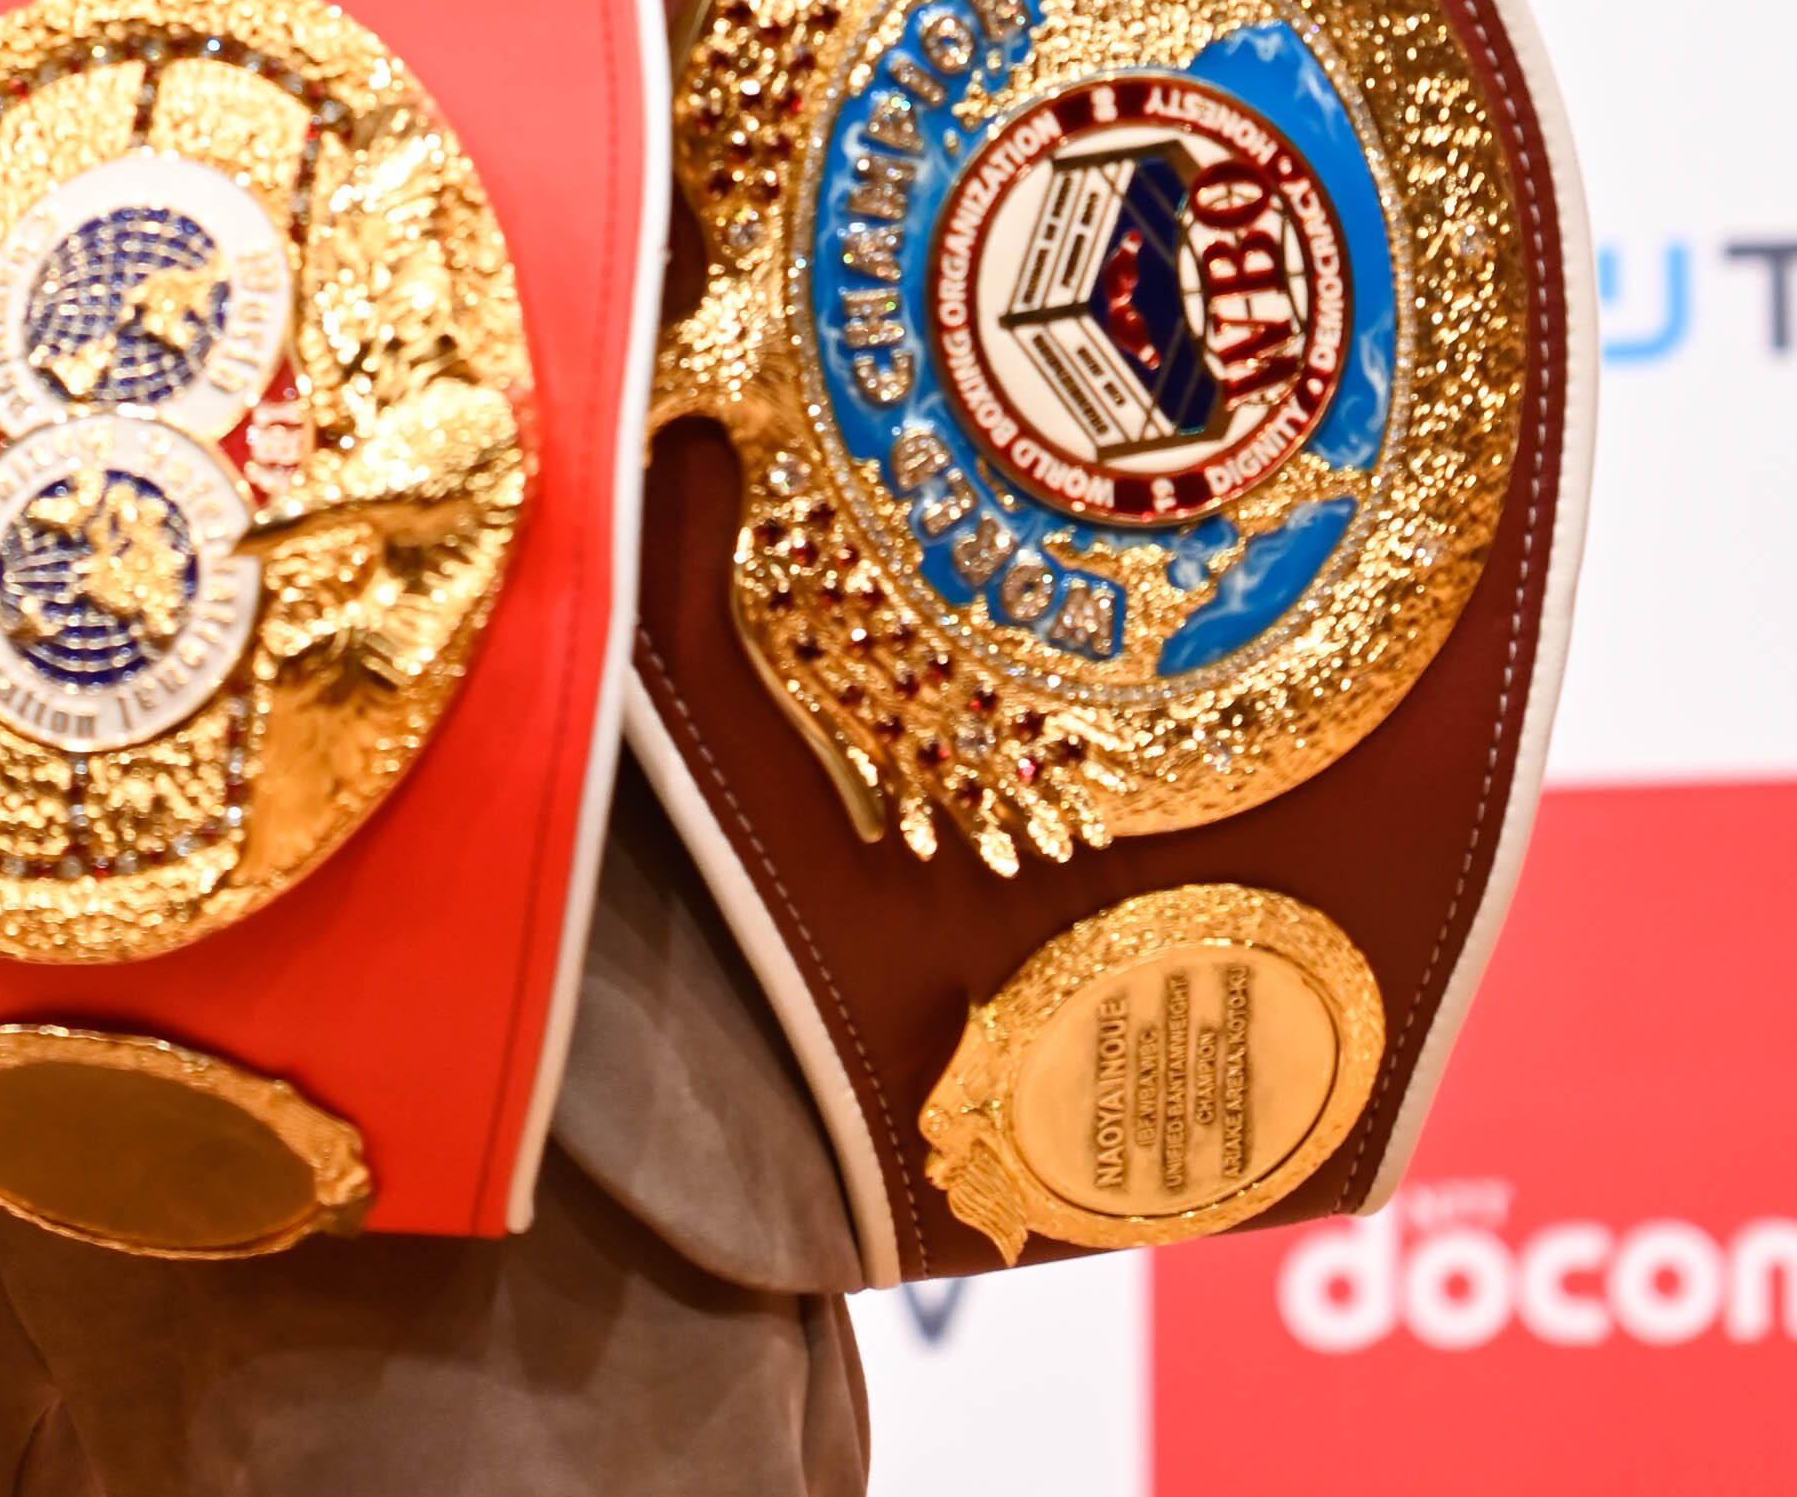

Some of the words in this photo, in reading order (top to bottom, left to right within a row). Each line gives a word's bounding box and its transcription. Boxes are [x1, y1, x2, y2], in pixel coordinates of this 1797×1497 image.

[1143, 86, 1279, 166] HONESTY
[936, 111, 1064, 324] ORGANIZATION
[1190, 158, 1308, 410] WBO
[1278, 178, 1344, 372] DEMOCRACY
[941, 326, 1017, 448] BOXING
[1011, 438, 1116, 509] WORLD
[1205, 394, 1308, 496] DIGNITY
[892, 424, 1125, 660] WORLD
[1097, 999, 1127, 1084] INOUE
[1195, 1030, 1217, 1125] CHAMPION
[1096, 1088, 1125, 1188] NAOYA
[1276, 1196, 1797, 1356] docom
